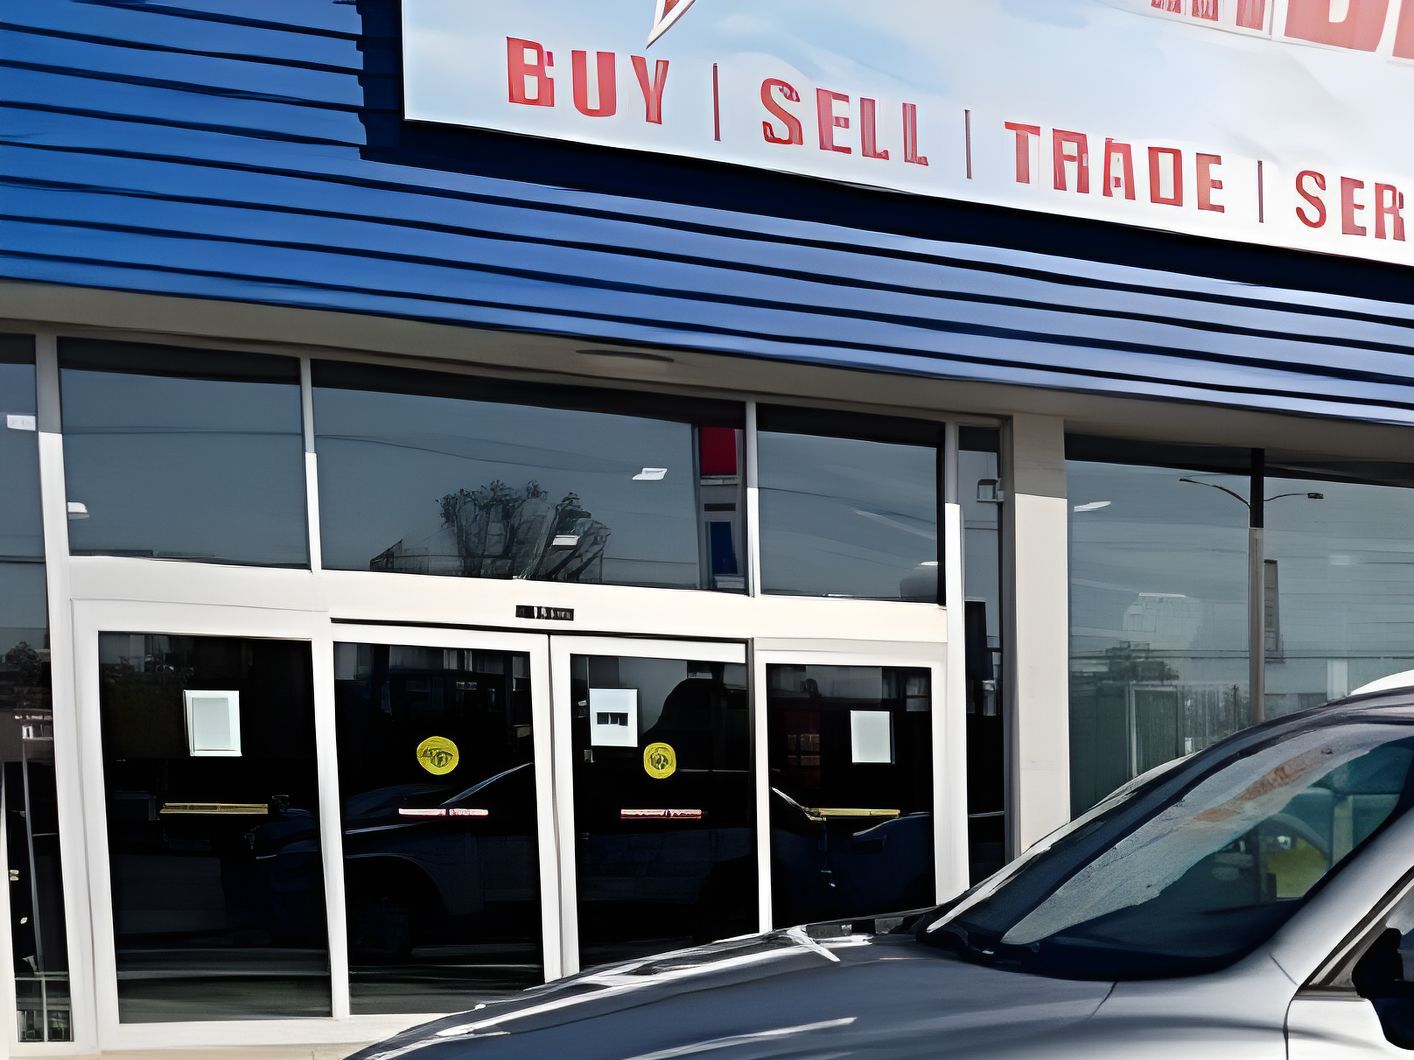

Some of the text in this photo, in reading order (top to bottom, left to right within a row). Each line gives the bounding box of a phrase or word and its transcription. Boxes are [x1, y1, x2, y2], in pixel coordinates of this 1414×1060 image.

[506, 36, 670, 124] BUY
[760, 78, 928, 167] SELL
[1004, 121, 1225, 213] TRADE
